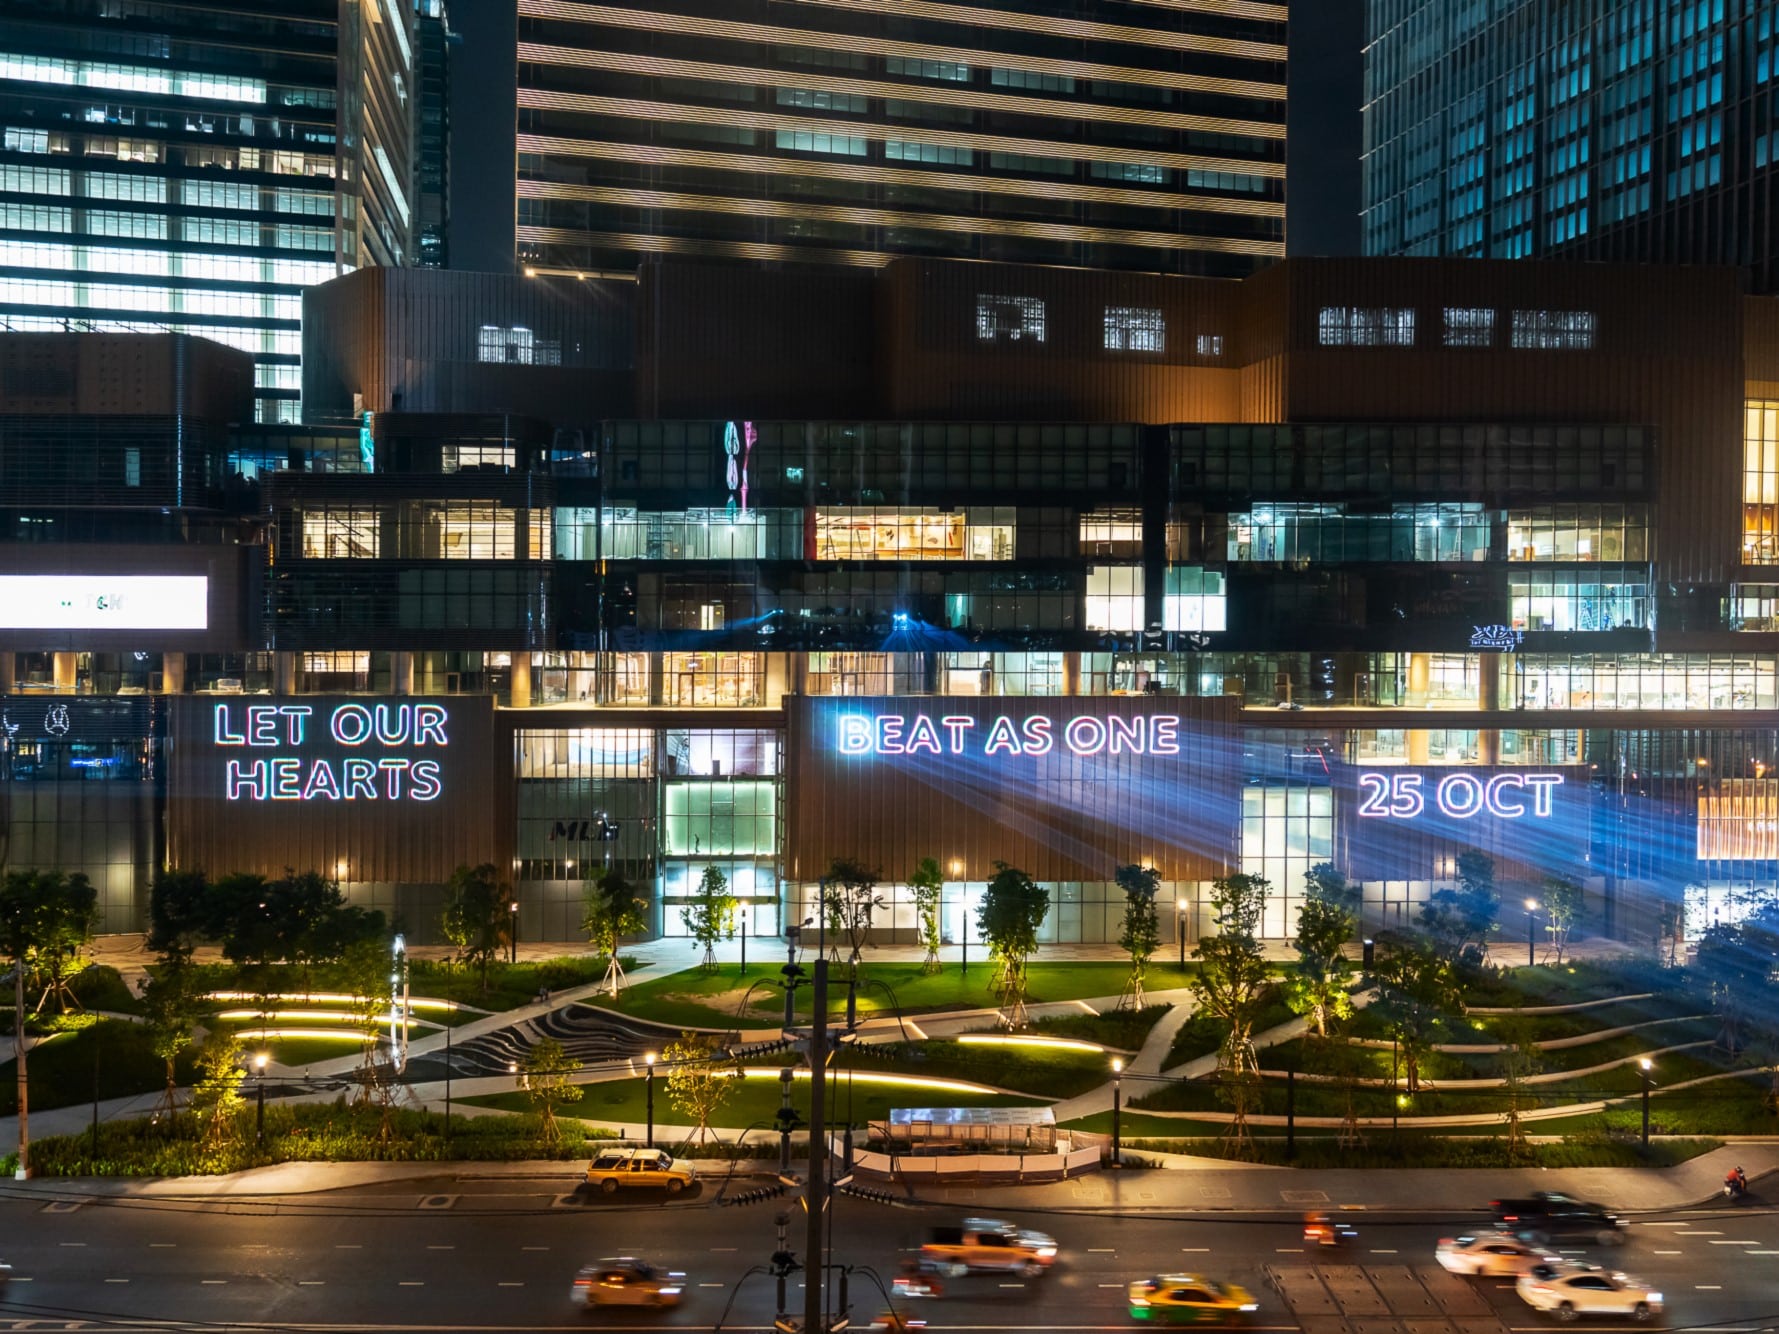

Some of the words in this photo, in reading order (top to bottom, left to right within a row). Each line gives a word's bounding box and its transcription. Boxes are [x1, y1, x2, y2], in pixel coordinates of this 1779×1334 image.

[215, 704, 312, 745] LET
[331, 704, 448, 746] OUR
[839, 715, 974, 754] BEAT
[985, 715, 1052, 755] AS
[1065, 715, 1180, 755] ONE
[227, 758, 441, 801] HEARTS
[1359, 773, 1424, 818] 25
[1437, 773, 1564, 818] OCT
